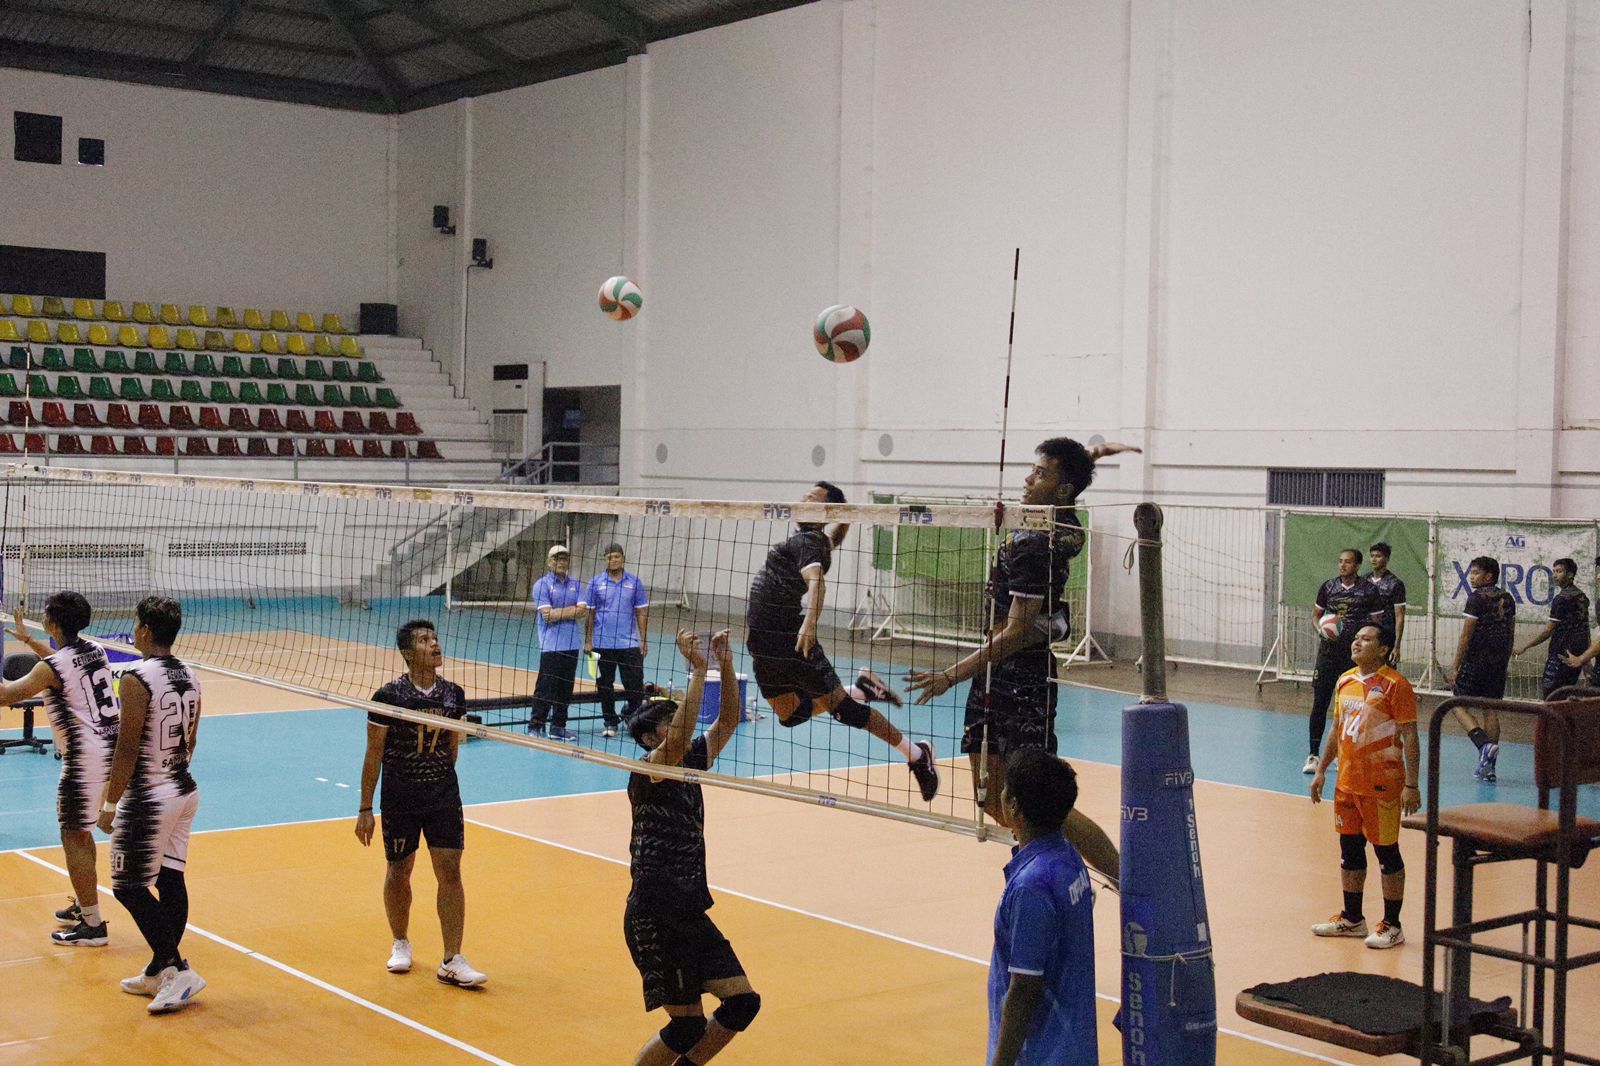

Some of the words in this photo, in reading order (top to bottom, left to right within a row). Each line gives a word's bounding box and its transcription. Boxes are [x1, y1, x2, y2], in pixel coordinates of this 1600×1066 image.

[1505, 536, 1526, 547] AG
[1452, 560, 1555, 606] XRO
[80, 667, 119, 723] 13
[416, 723, 442, 754] 17
[1341, 713, 1361, 744] 14
